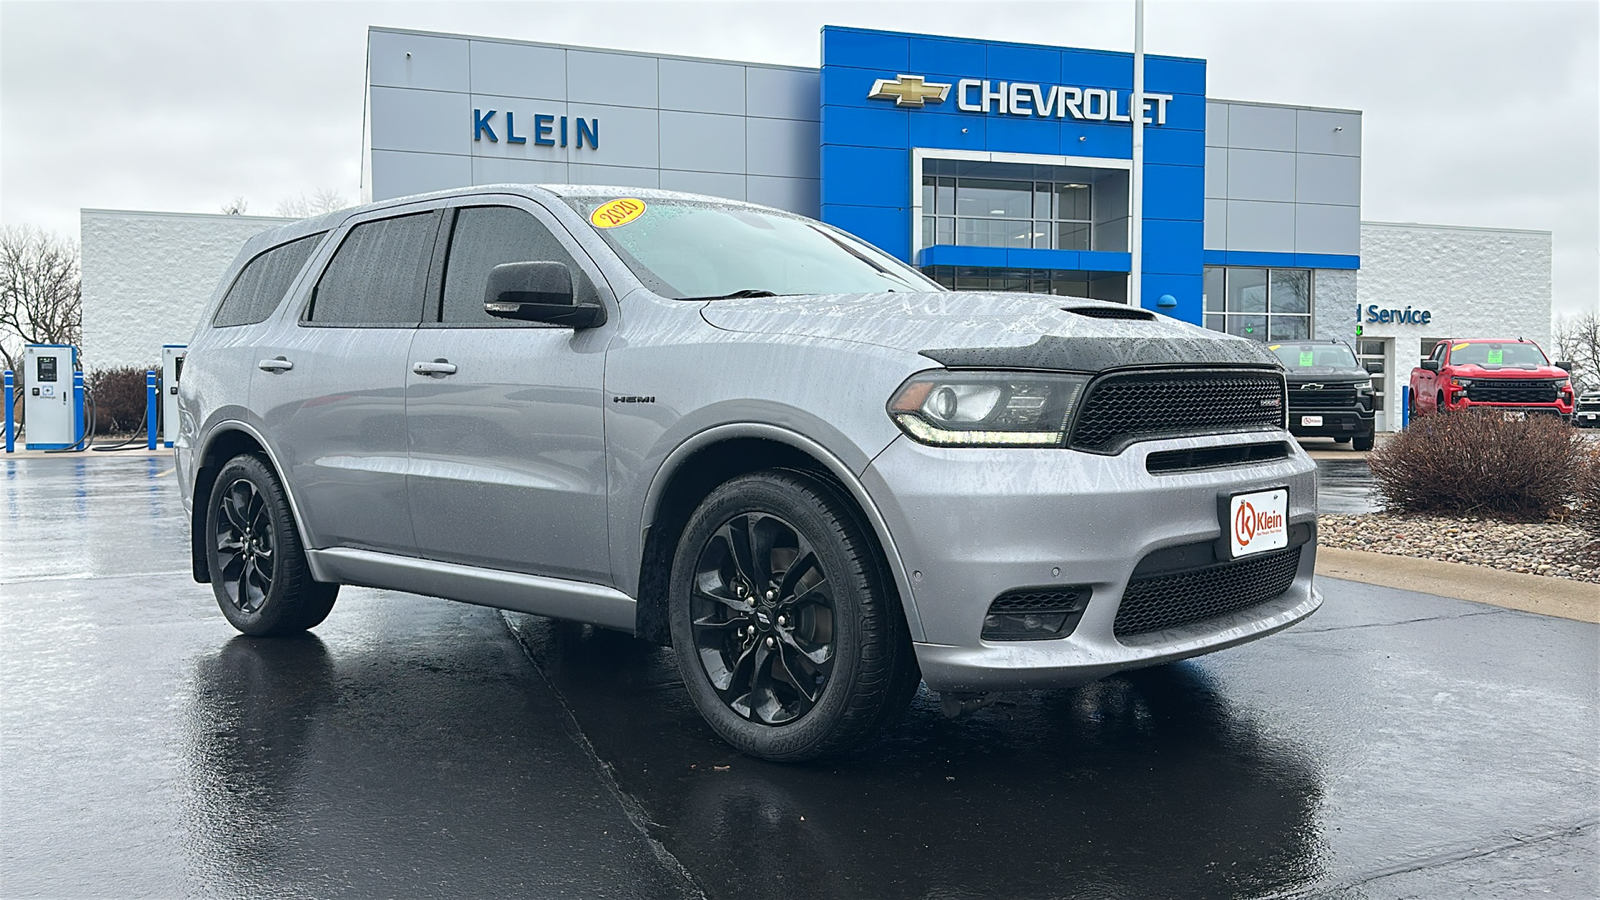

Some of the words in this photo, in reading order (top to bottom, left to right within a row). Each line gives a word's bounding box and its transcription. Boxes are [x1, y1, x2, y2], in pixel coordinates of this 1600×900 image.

[957, 78, 1173, 124] CHEVROLET
[473, 109, 599, 149] KLEIN
[600, 201, 638, 224] 2020
[1368, 304, 1431, 323] Service
[1257, 510, 1282, 531] Klein
